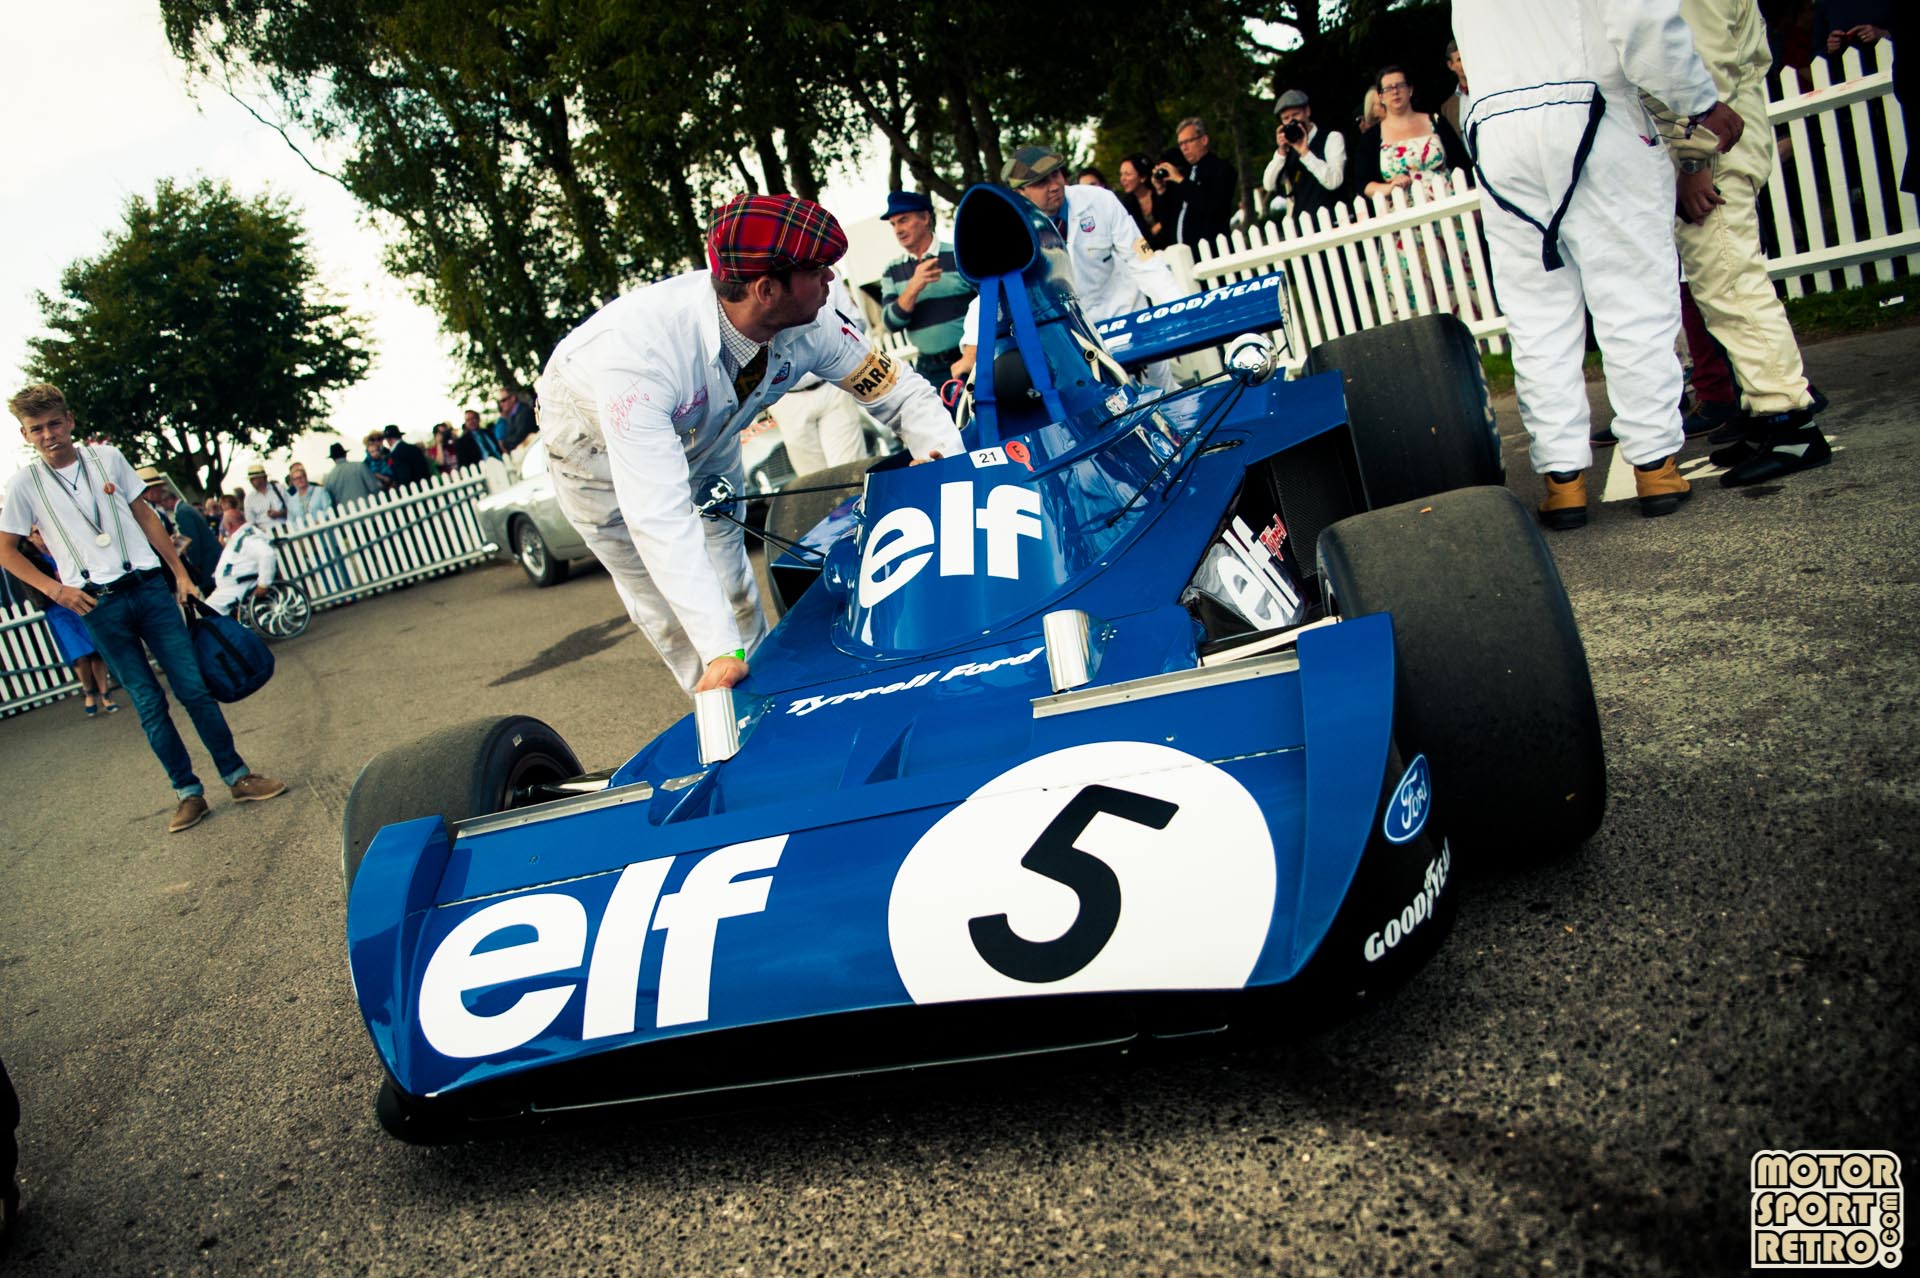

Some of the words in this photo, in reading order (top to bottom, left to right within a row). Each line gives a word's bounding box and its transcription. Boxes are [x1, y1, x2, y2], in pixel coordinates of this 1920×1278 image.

[1136, 276, 1280, 324] GOODYEAR
[978, 451, 997, 464] 21
[858, 480, 1043, 609] elf
[1217, 515, 1300, 632] elf
[786, 671, 941, 717] Tyrrell
[939, 646, 1046, 683] Ford
[968, 784, 1180, 984] 5
[418, 834, 790, 1059] elf
